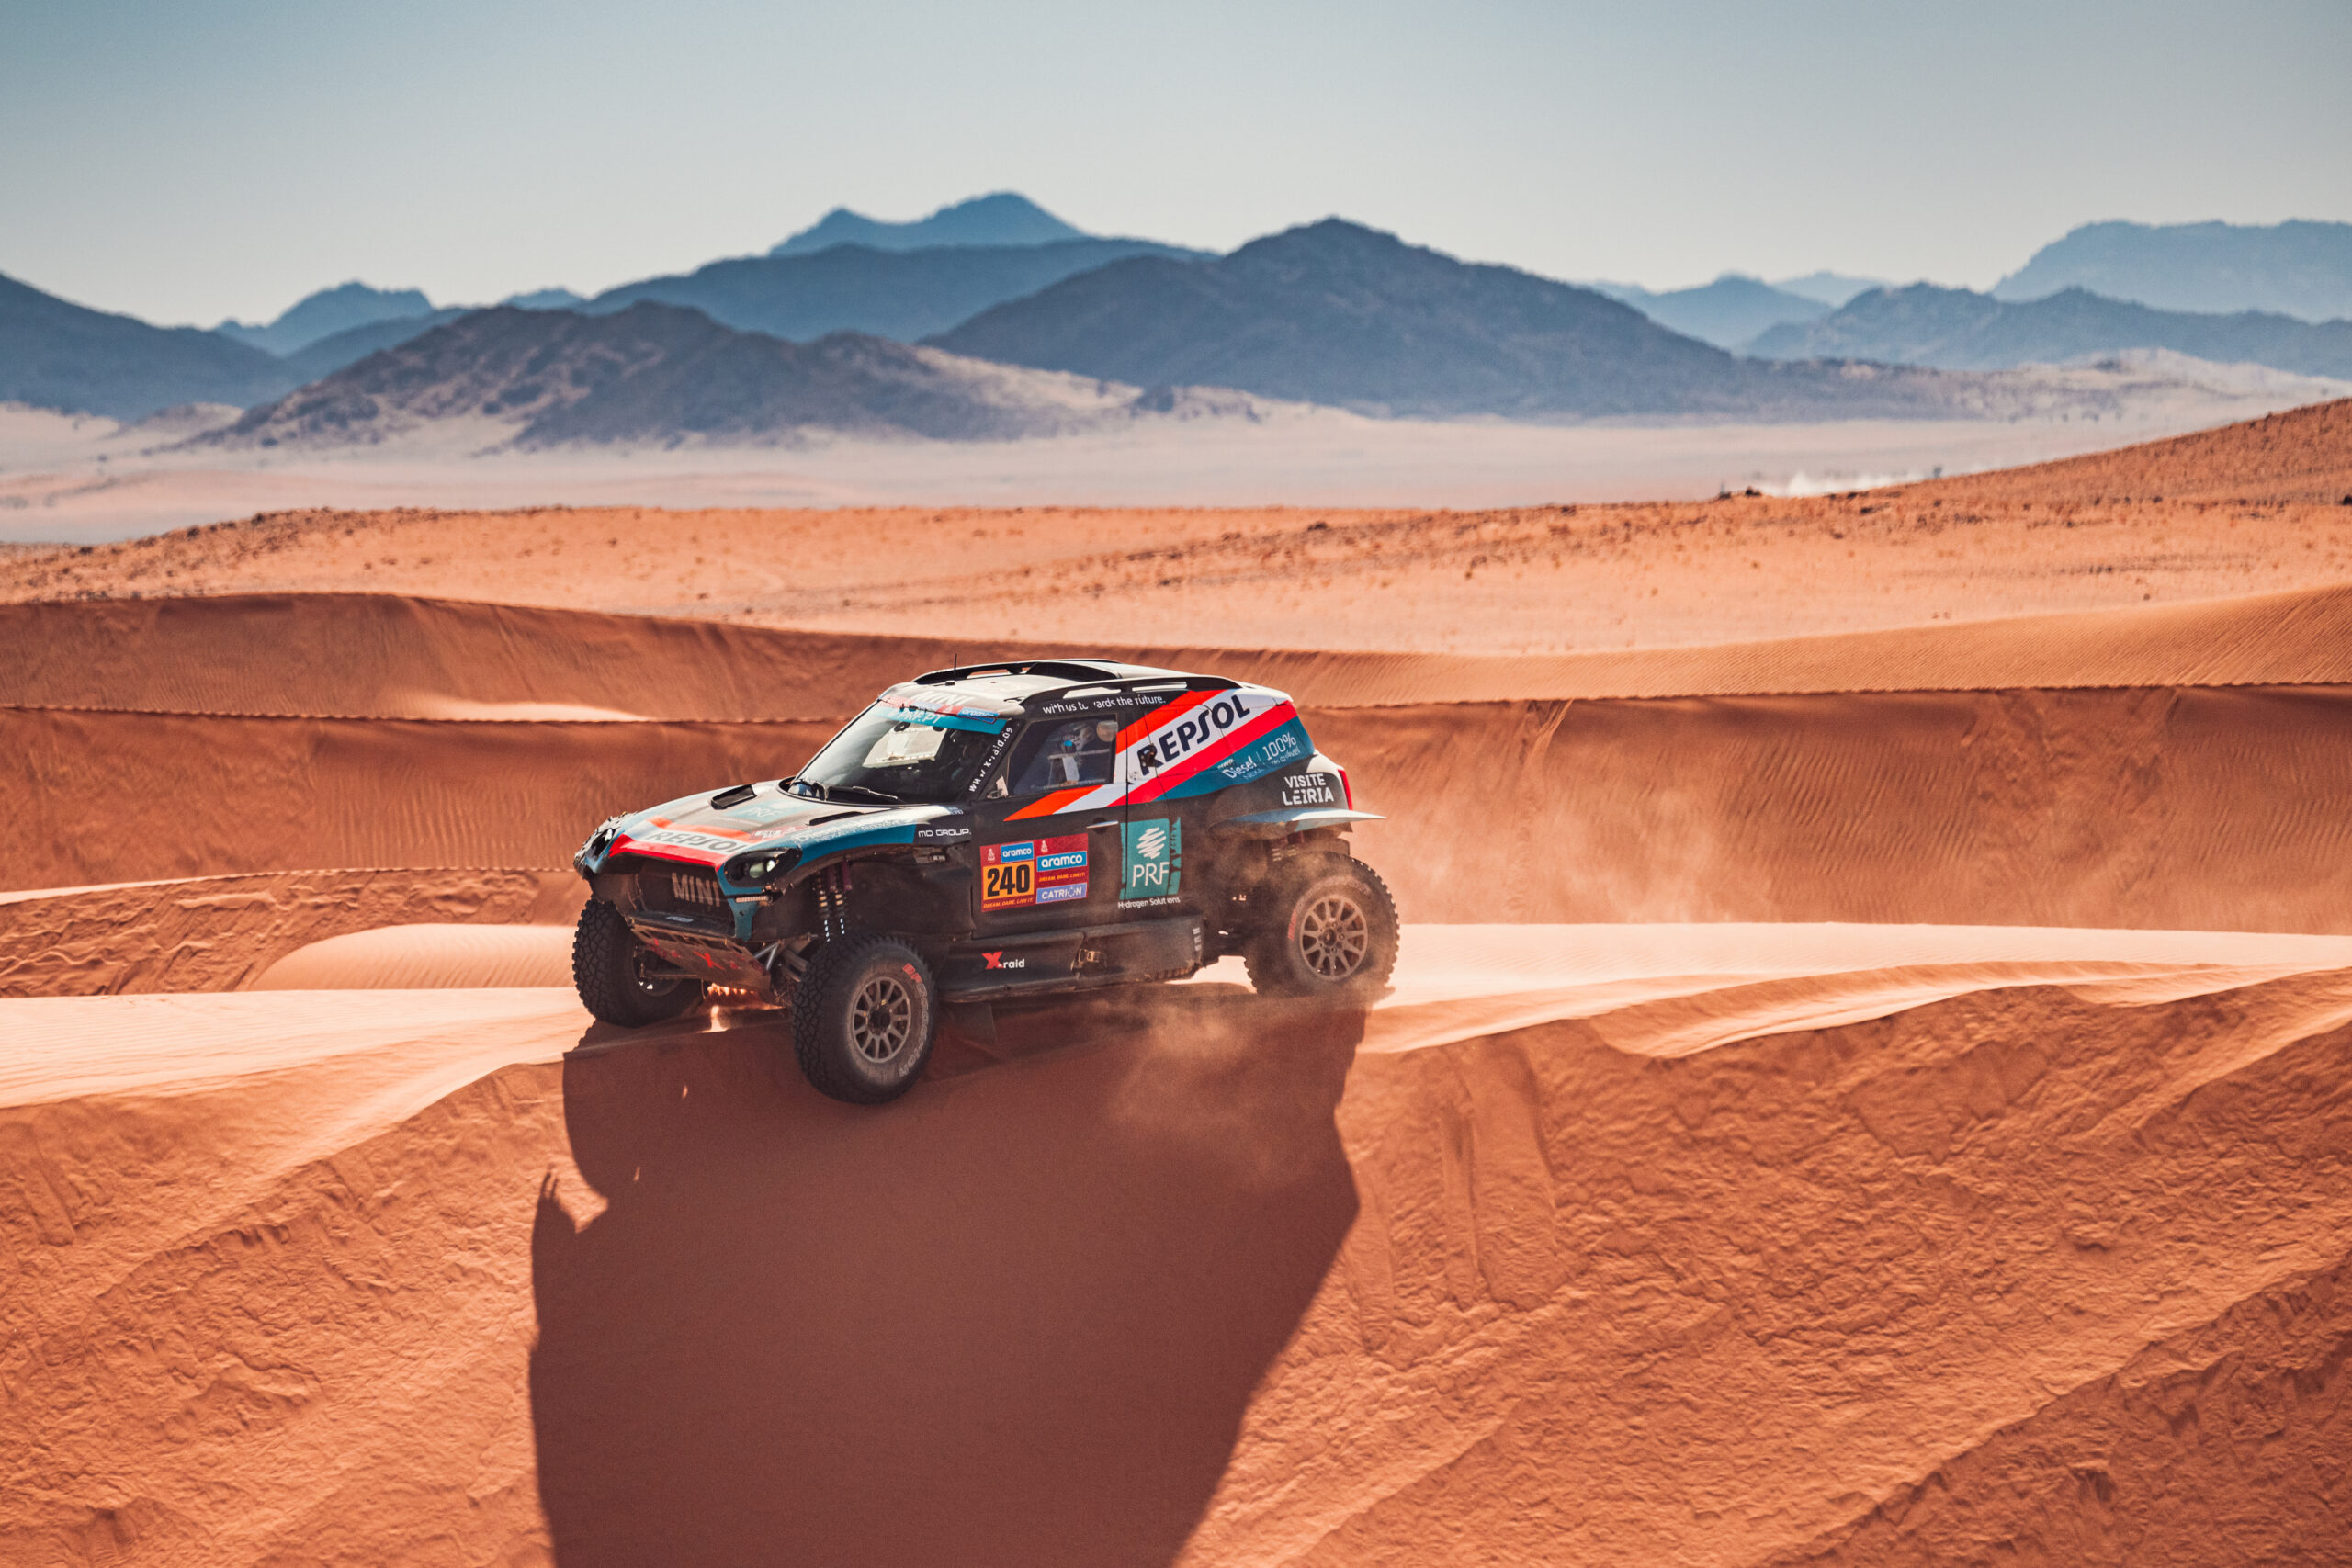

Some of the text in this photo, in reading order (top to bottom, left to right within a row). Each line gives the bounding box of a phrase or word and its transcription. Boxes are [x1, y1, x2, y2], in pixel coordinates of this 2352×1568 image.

[1066, 704, 1077, 712] us
[1078, 698, 1115, 710] toards
[1116, 696, 1134, 706] the
[1137, 694, 1250, 776] REPSOL
[1222, 755, 1258, 779] Diesel
[1262, 732, 1297, 761] 100%
[1284, 773, 1326, 788] VISITE
[1282, 787, 1335, 806] LEIRIA
[646, 831, 747, 853] REPSOL
[1002, 848, 1032, 858] aramco
[1041, 854, 1083, 868] aramco
[987, 864, 1030, 897] 240
[1132, 862, 1170, 887] PRF
[672, 872, 720, 908] MINI
[982, 951, 1025, 969] X-raid
